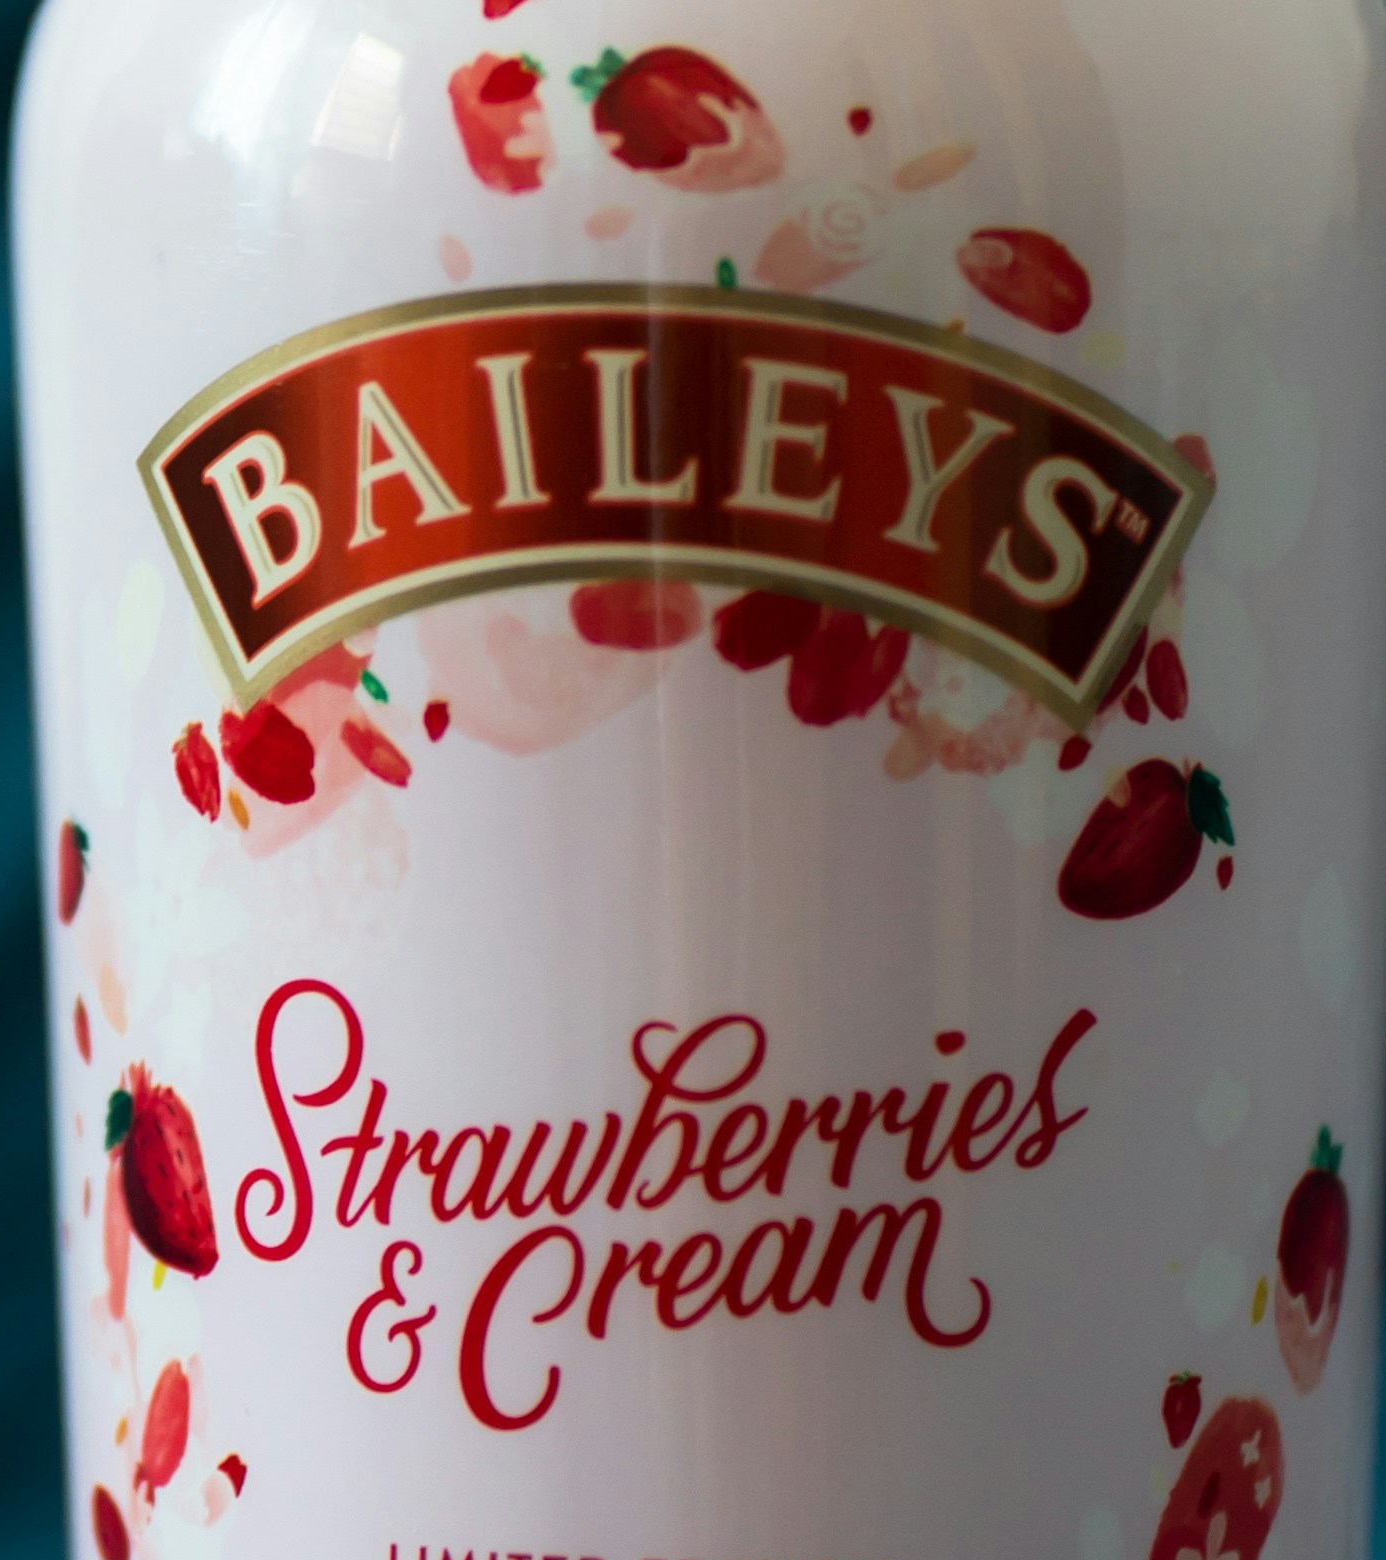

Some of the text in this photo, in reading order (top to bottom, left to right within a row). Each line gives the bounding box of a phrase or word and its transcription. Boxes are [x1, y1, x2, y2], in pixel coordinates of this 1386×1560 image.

[203, 347, 1117, 608] BAILEYS
[235, 978, 1098, 1262] Strawberries
[346, 1197, 992, 1432] & Cream
